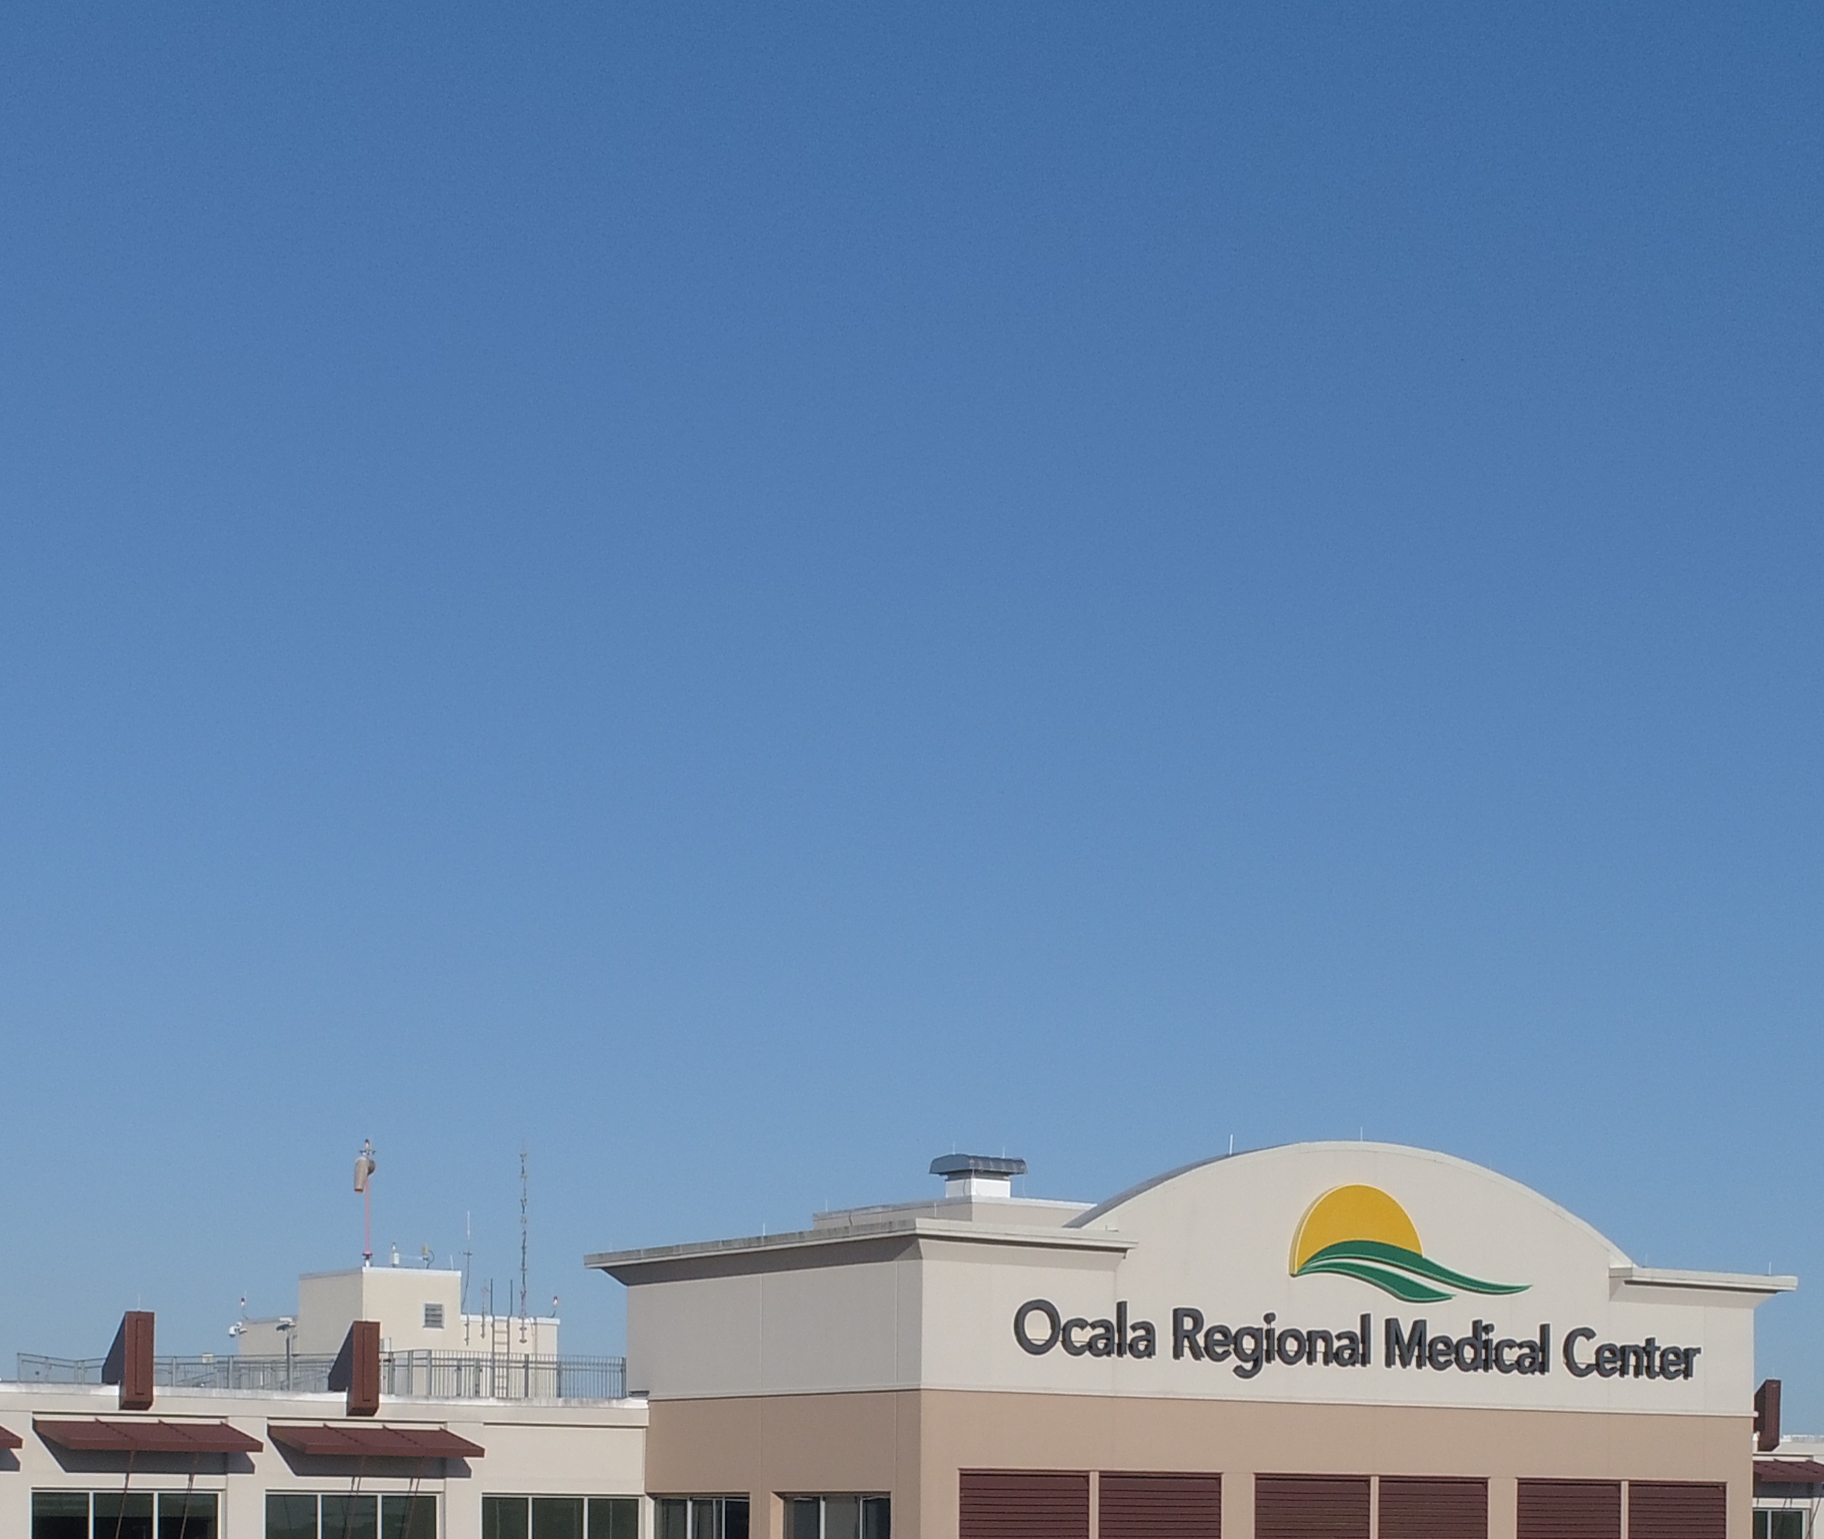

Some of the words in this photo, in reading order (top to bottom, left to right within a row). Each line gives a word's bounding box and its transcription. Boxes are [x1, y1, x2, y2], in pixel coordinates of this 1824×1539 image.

[1013, 1299, 1157, 1360] Ocala
[1172, 1307, 1371, 1379] Regional
[1385, 1316, 1551, 1375] Medical
[1563, 1327, 1702, 1381] Center
